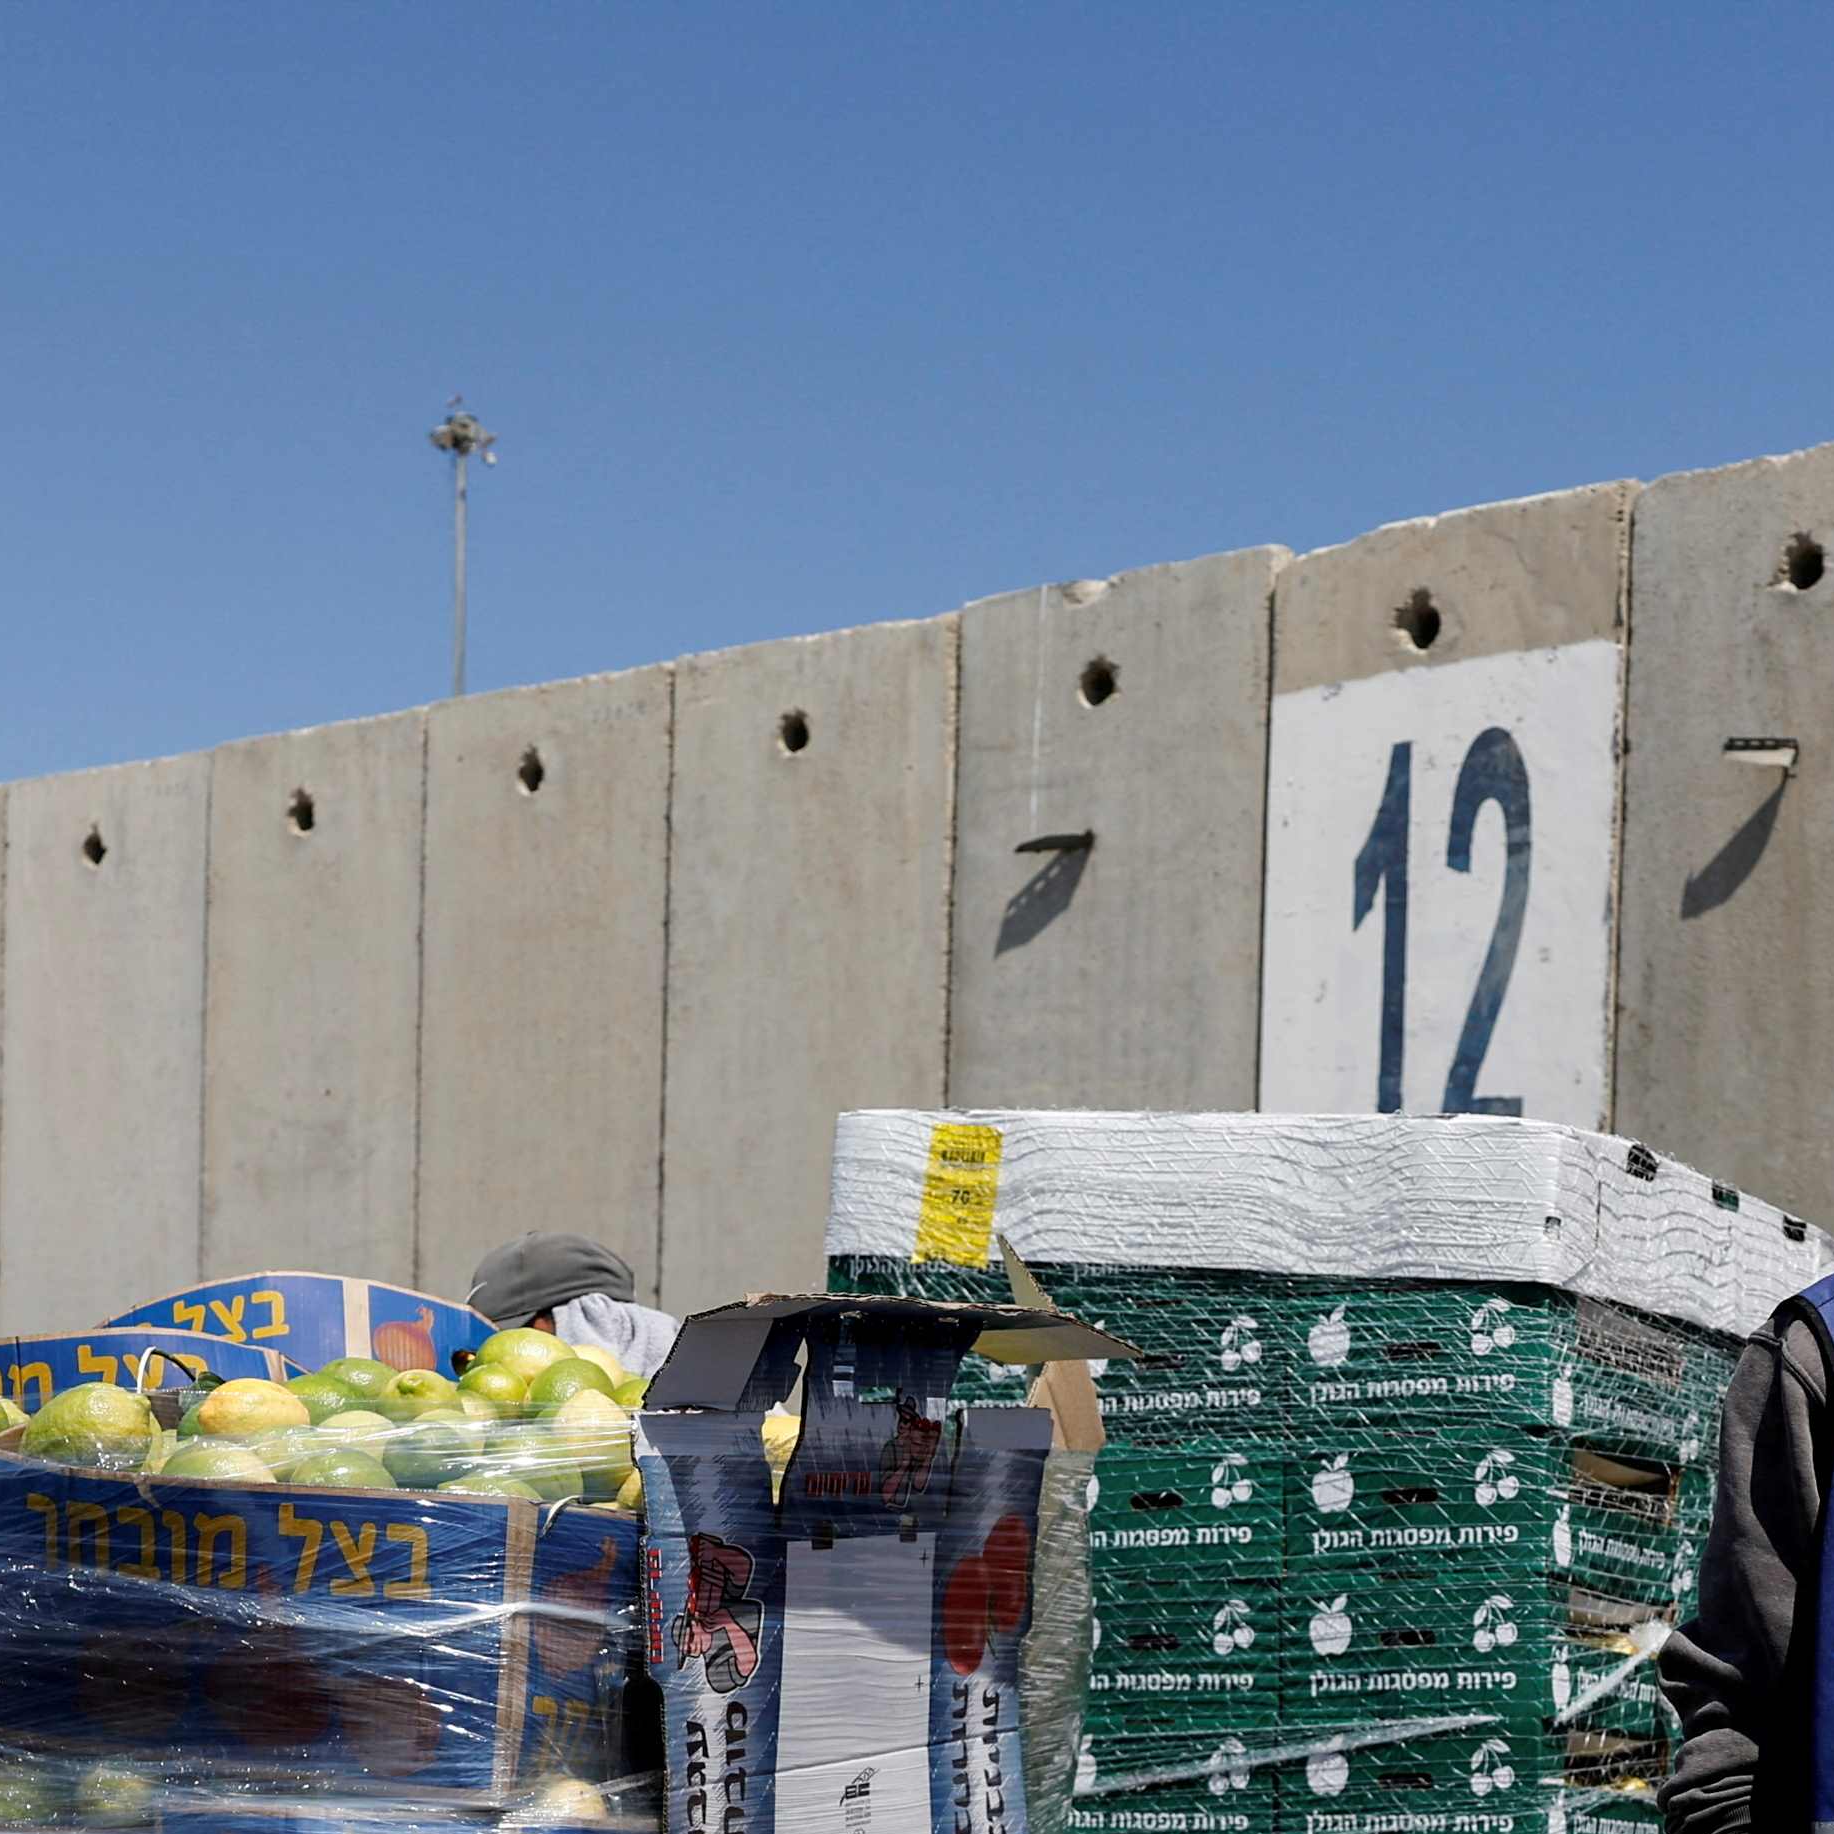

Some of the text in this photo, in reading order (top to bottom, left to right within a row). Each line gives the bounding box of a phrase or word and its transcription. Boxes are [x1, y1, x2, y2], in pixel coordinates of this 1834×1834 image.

[1352, 725, 1533, 1118] 12
[26, 1492, 433, 1600] בצל מובחר
[1115, 1673, 1254, 1692] פירות מפסגות
[1309, 1671, 1517, 1697] פירות מפסגות הגולן
